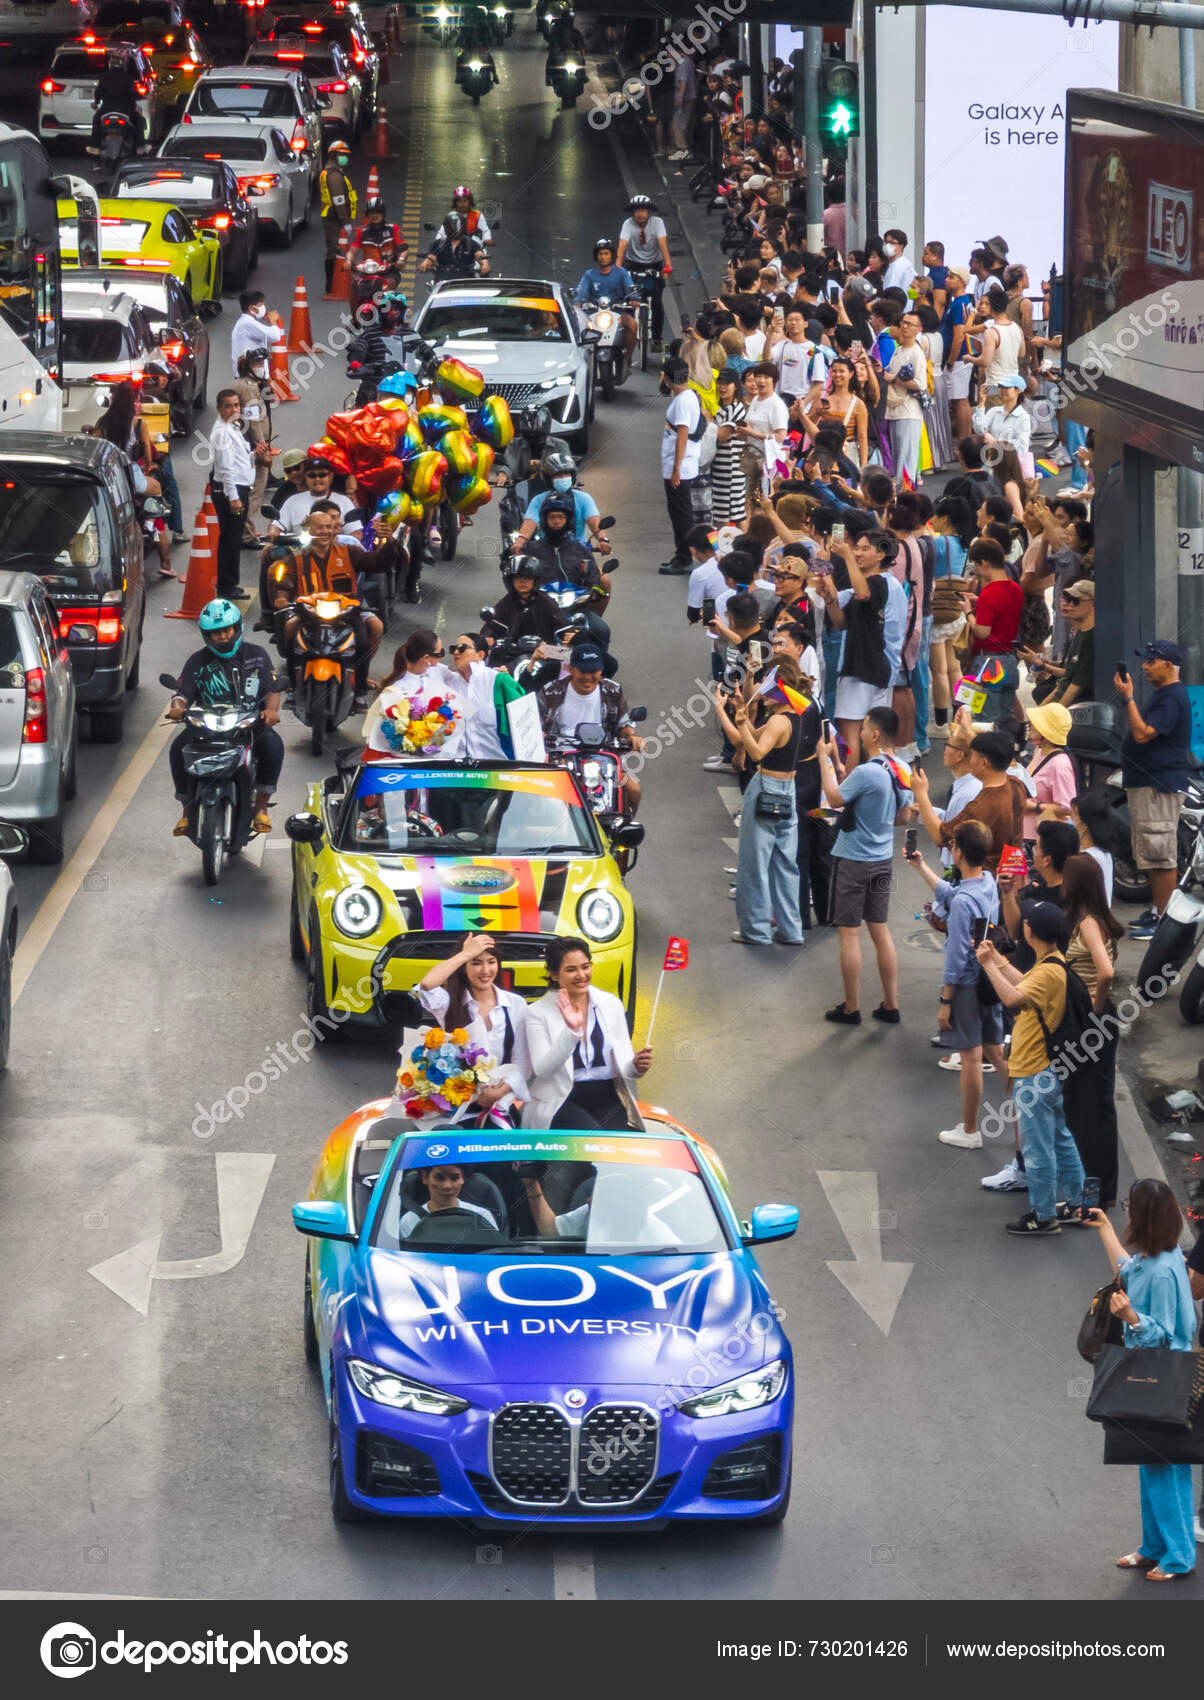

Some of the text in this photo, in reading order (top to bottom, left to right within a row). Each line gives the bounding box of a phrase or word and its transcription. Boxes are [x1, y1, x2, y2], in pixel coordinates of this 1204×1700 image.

[968, 103, 1064, 125] Galaxy A
[985, 127, 1058, 145] is here
[1150, 192, 1189, 265] LEO
[336, 558, 344, 567] 3
[458, 1143, 532, 1153] Millennium
[534, 1142, 568, 1151] Auto
[412, 1263, 703, 1318] JOY
[415, 1318, 709, 1344] WITH DIVERSITY
